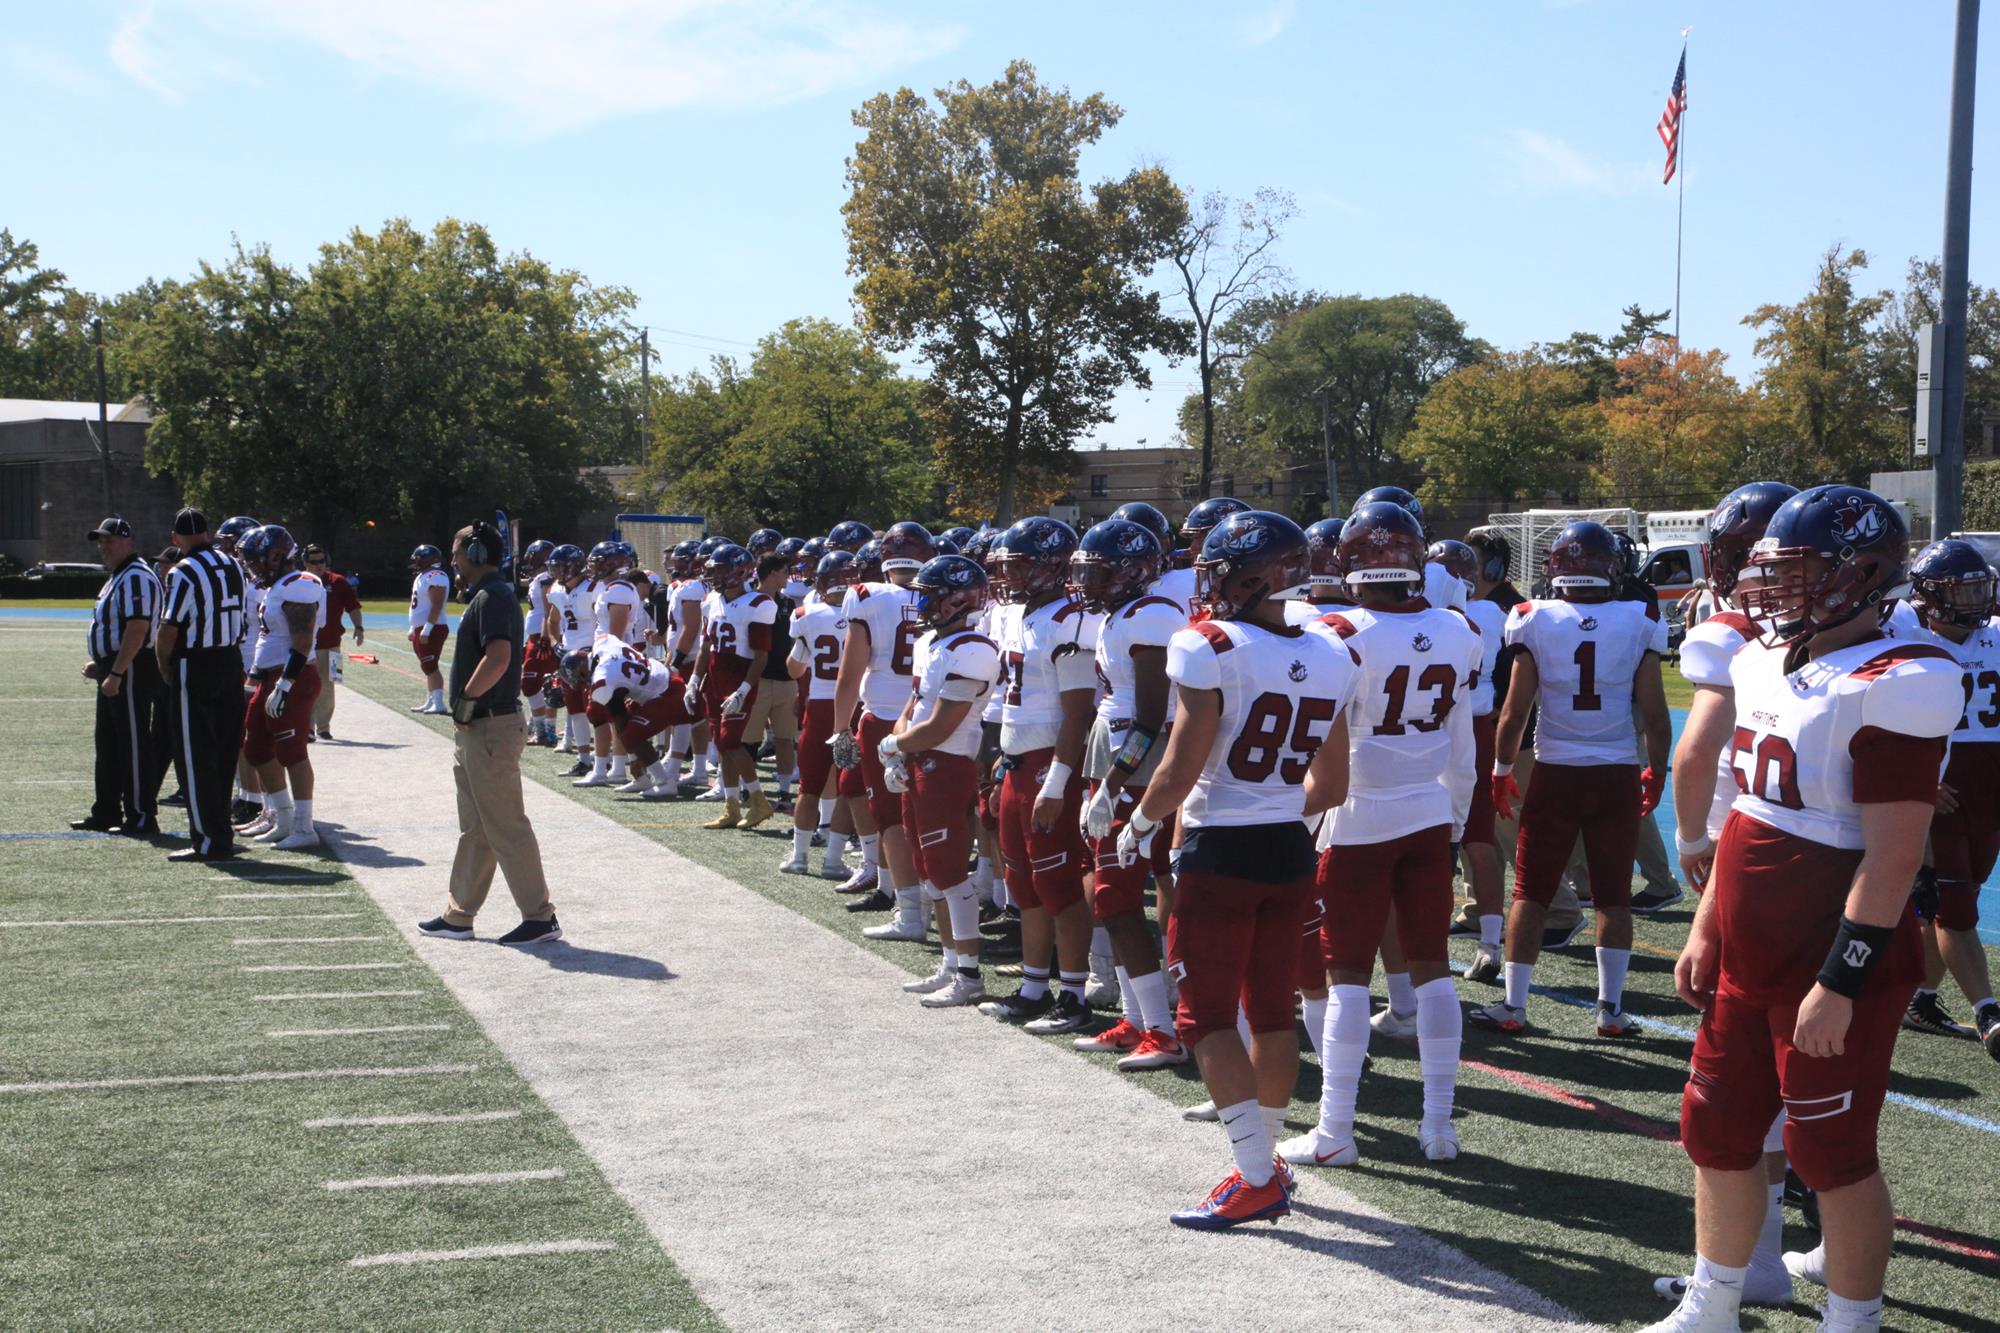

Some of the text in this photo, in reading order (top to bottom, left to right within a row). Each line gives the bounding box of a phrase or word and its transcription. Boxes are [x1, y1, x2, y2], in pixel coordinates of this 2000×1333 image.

[215, 569, 240, 608] L
[1361, 572, 1407, 580] PRIVATEERS
[814, 634, 846, 680] 2
[1573, 640, 1601, 711] 1
[1373, 664, 1456, 735] 13
[1227, 691, 1336, 785] 85
[1729, 725, 1806, 811] 50
